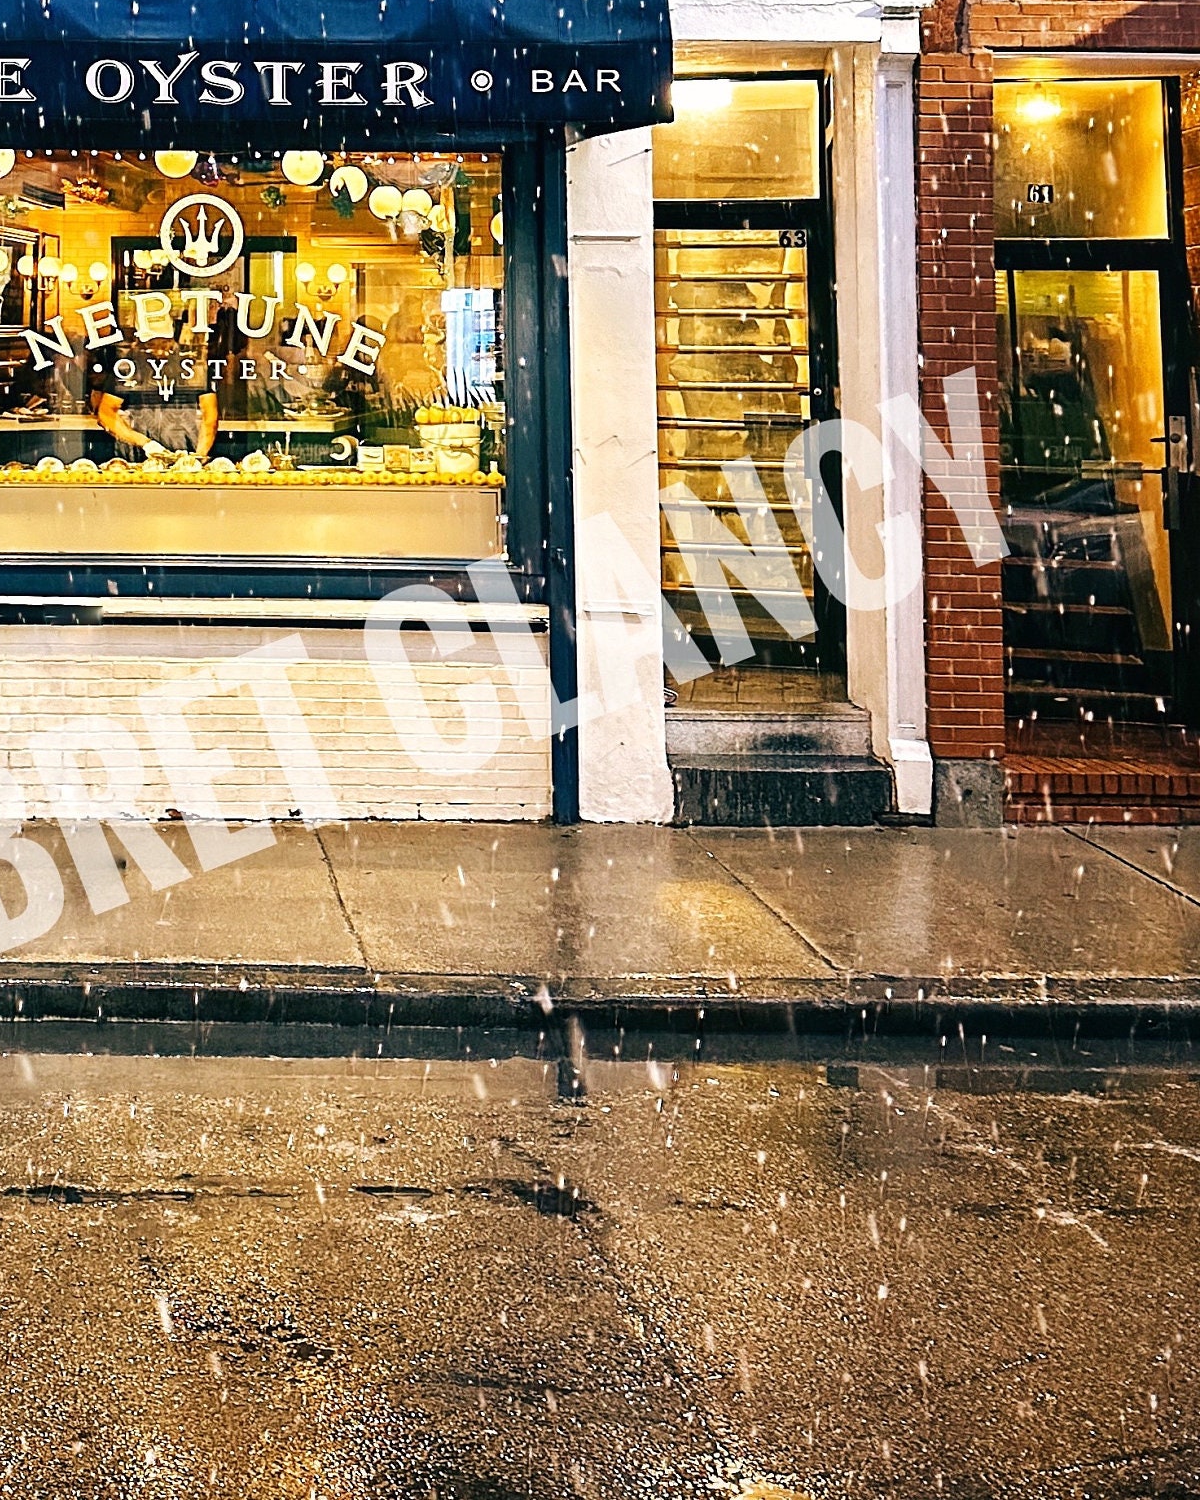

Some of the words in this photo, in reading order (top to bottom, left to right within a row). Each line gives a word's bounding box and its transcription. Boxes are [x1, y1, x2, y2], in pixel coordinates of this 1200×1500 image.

[85, 51, 434, 109] OYSTER
[531, 69, 622, 93] BAR
[1030, 185, 1050, 204] 61
[779, 230, 806, 248] 63
[19, 289, 387, 376] NEPTUNE
[113, 358, 293, 381] OYSTER
